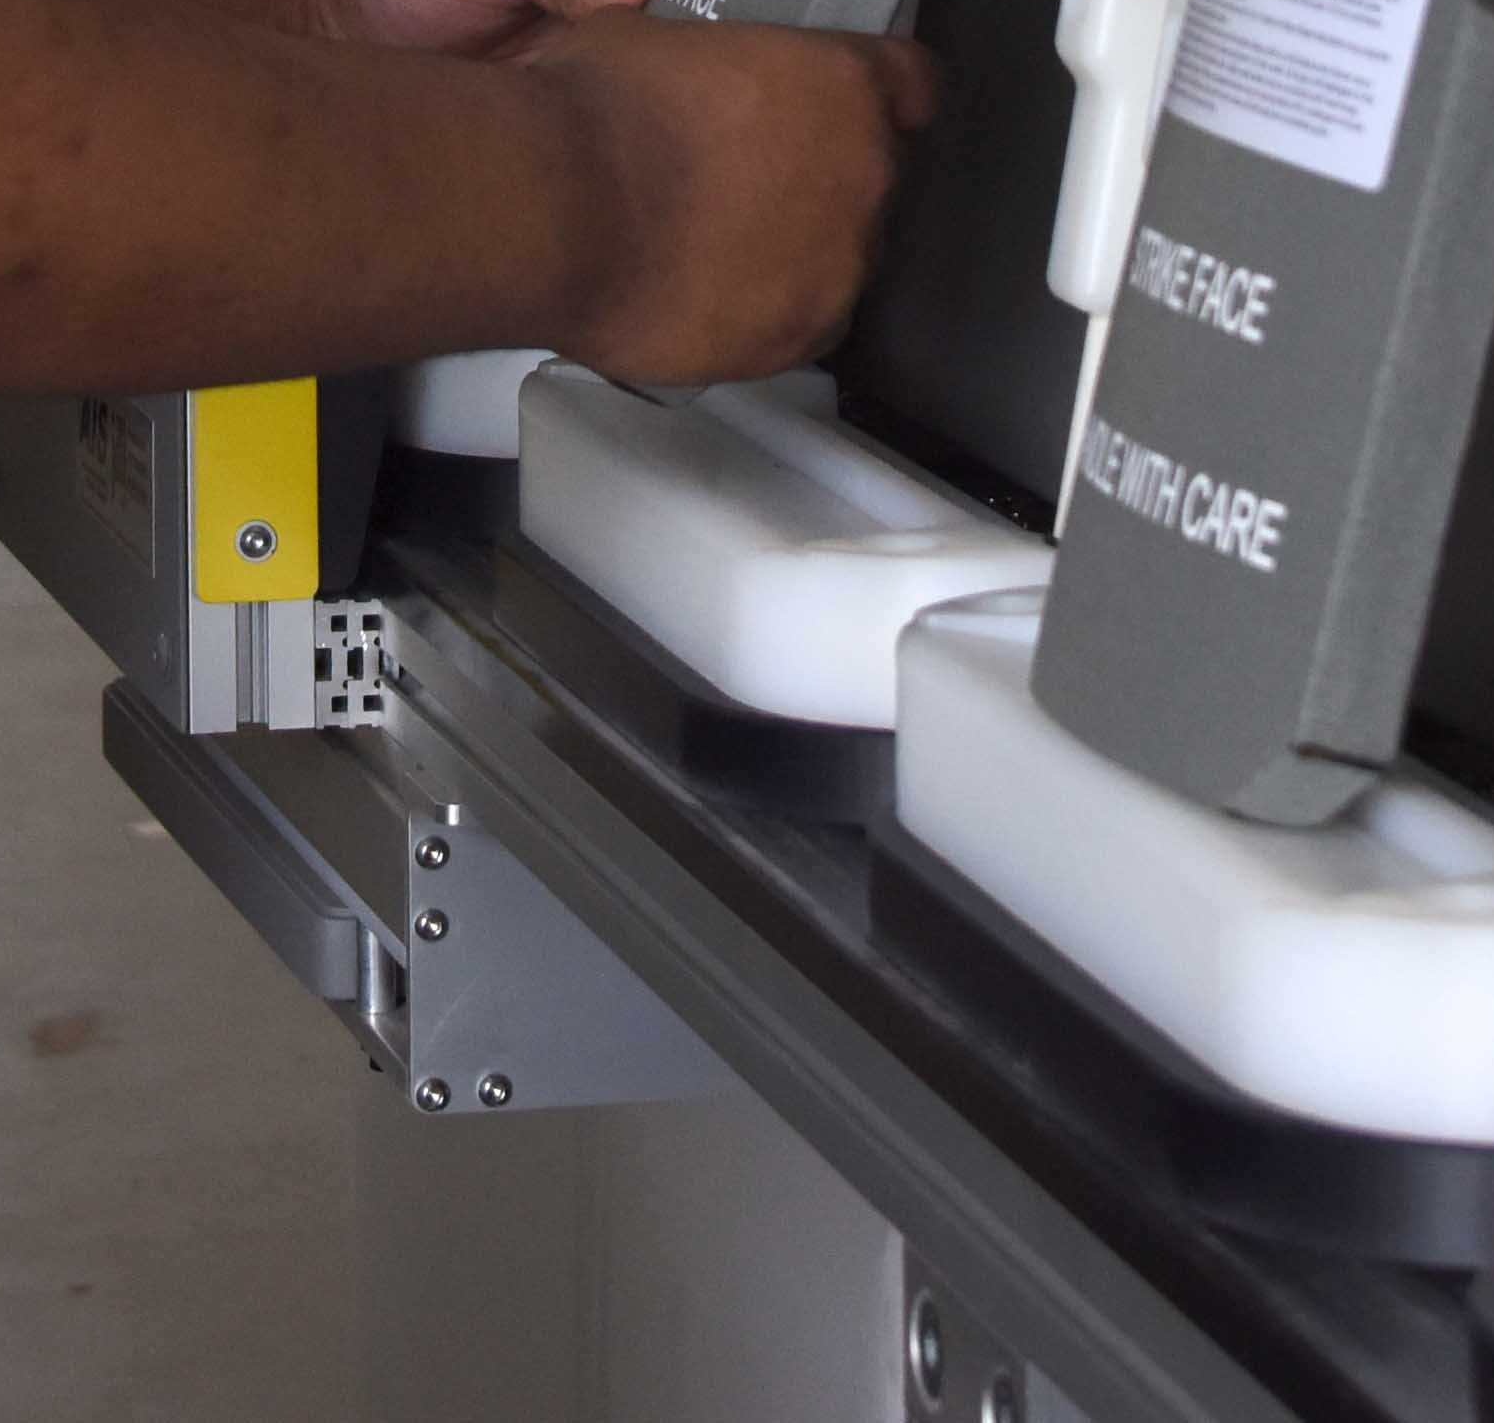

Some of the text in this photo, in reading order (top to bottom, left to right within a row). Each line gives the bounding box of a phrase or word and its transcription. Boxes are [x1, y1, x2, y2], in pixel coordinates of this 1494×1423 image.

[1187, 252, 1276, 344] FACE
[1116, 438, 1187, 530] WITH
[1180, 470, 1289, 574] CARE
